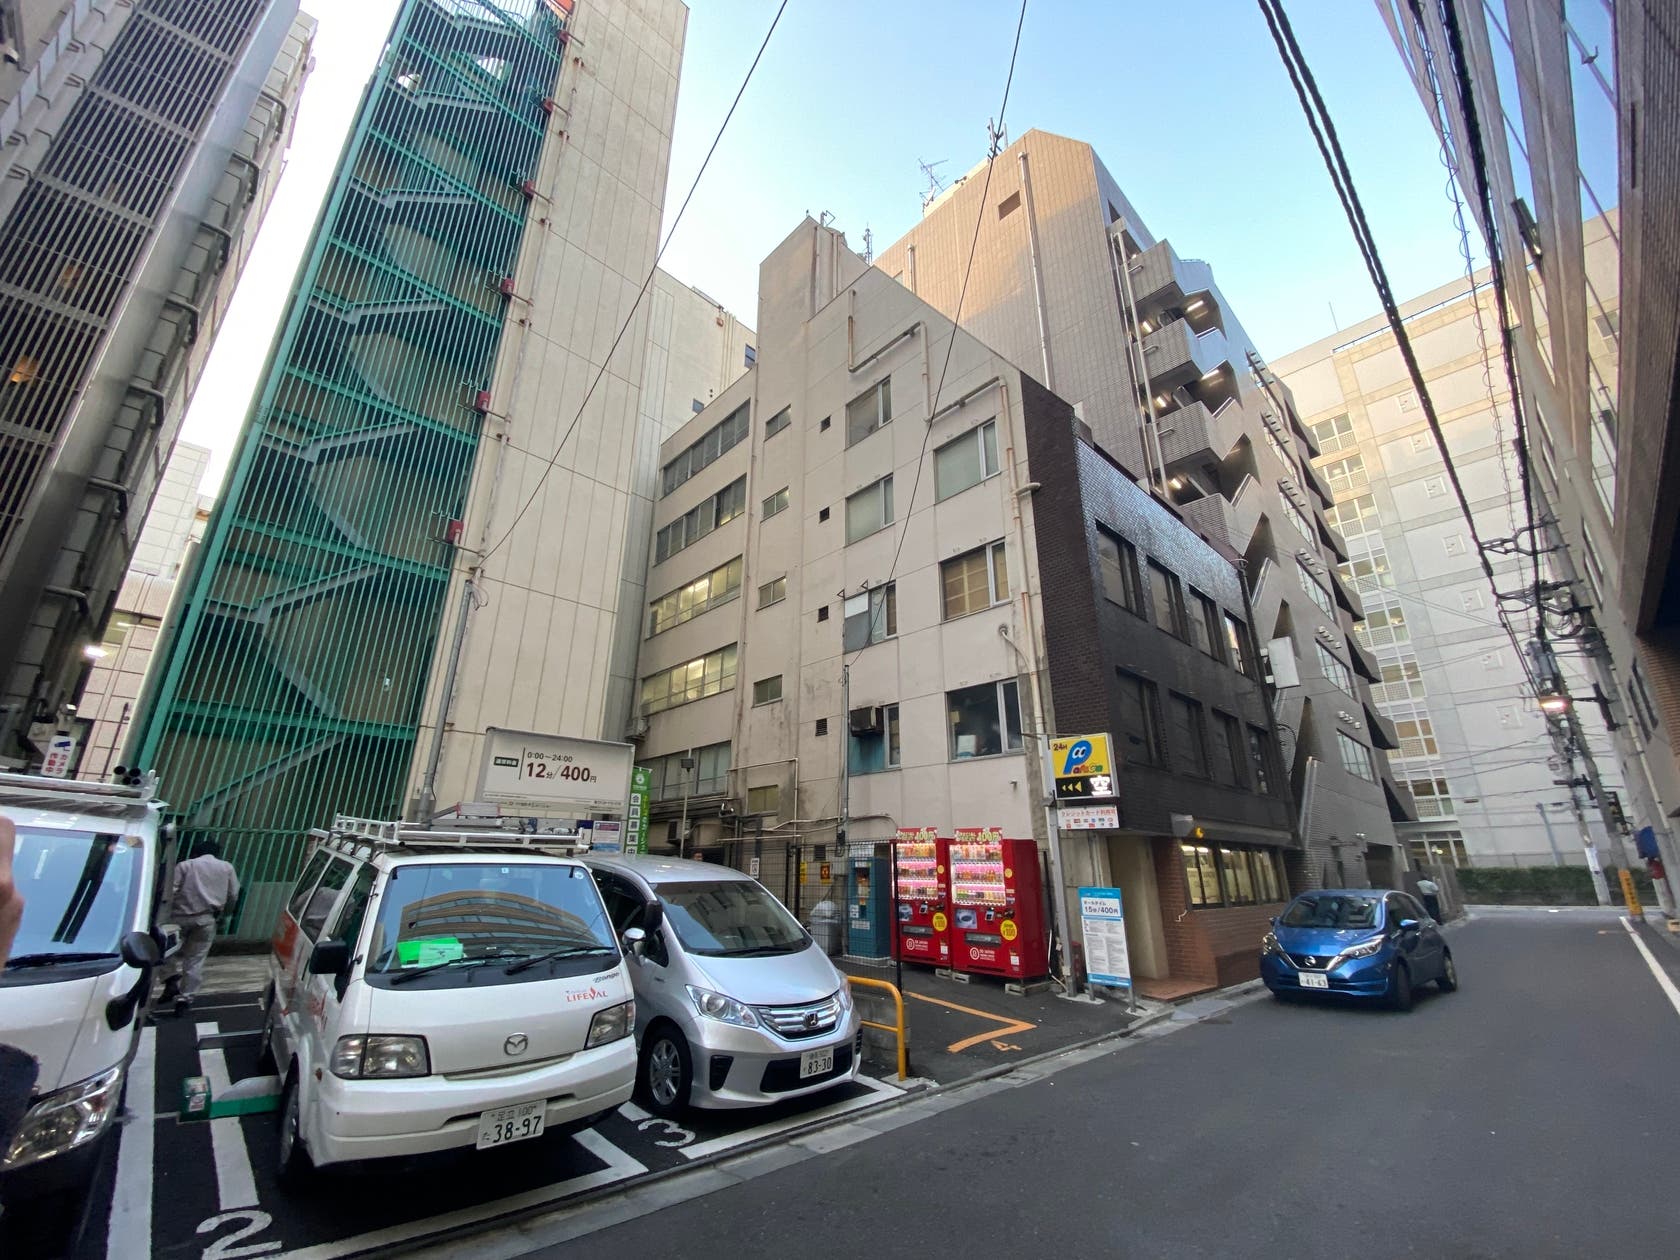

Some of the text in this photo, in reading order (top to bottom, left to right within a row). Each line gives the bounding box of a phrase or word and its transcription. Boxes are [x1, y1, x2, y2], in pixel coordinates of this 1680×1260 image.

[566, 986, 609, 1002] LIFEVAL
[492, 1115, 542, 1143] 38-97
[637, 1118, 696, 1147] 3
[195, 1209, 282, 1260] 2
